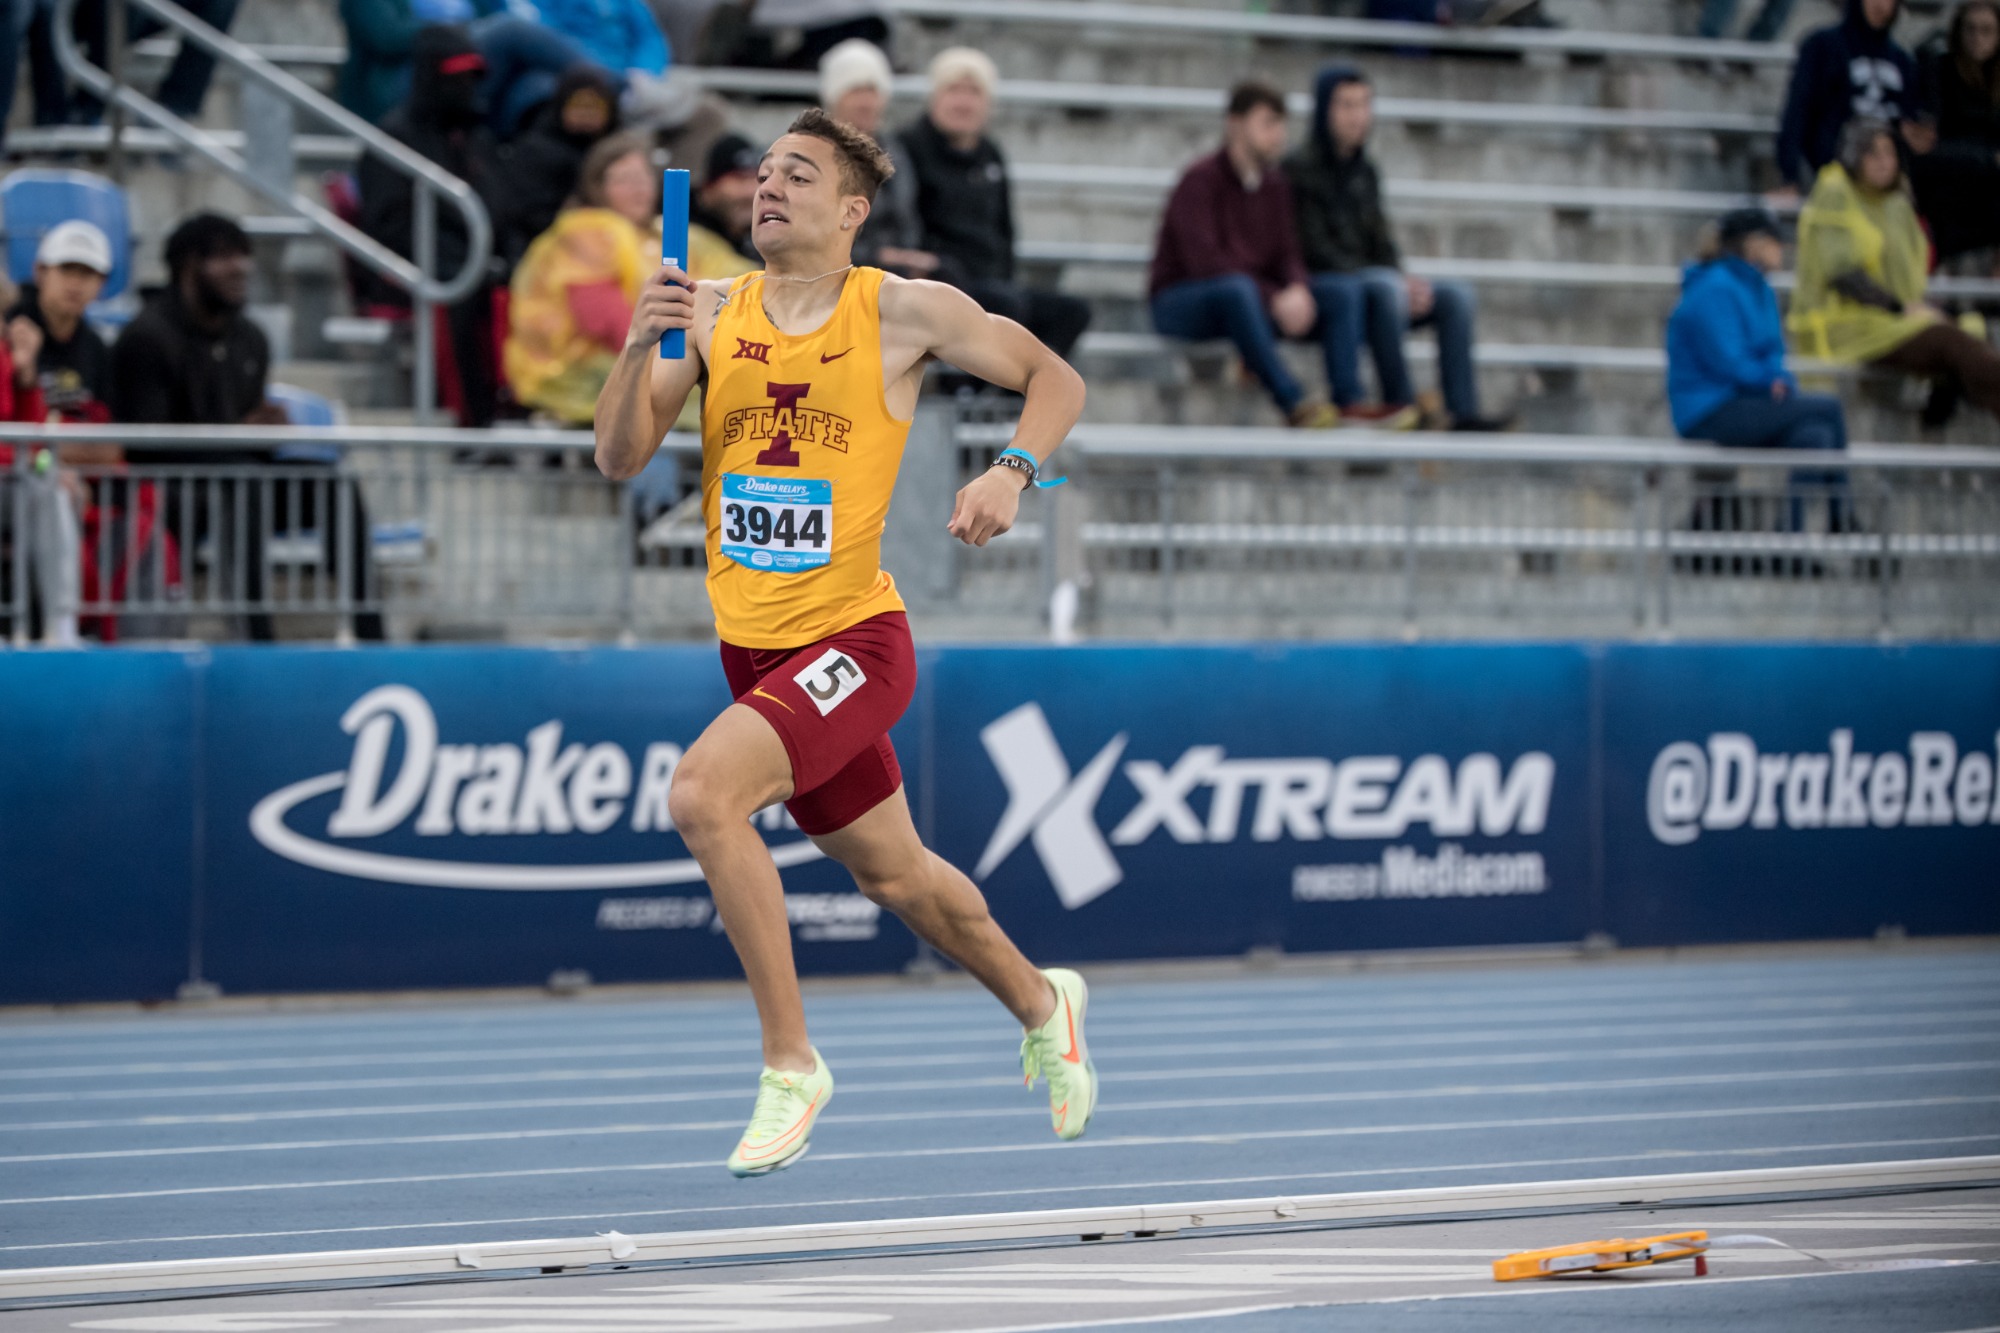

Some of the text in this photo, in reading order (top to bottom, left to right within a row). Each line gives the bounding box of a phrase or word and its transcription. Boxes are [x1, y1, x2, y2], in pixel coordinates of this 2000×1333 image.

[723, 406, 852, 454] STATE
[745, 477, 807, 494] Drake RELAYS
[725, 503, 826, 548] 3944
[805, 655, 858, 700] 5
[327, 684, 633, 838] Drake
[1110, 745, 1556, 846] XTREAM
